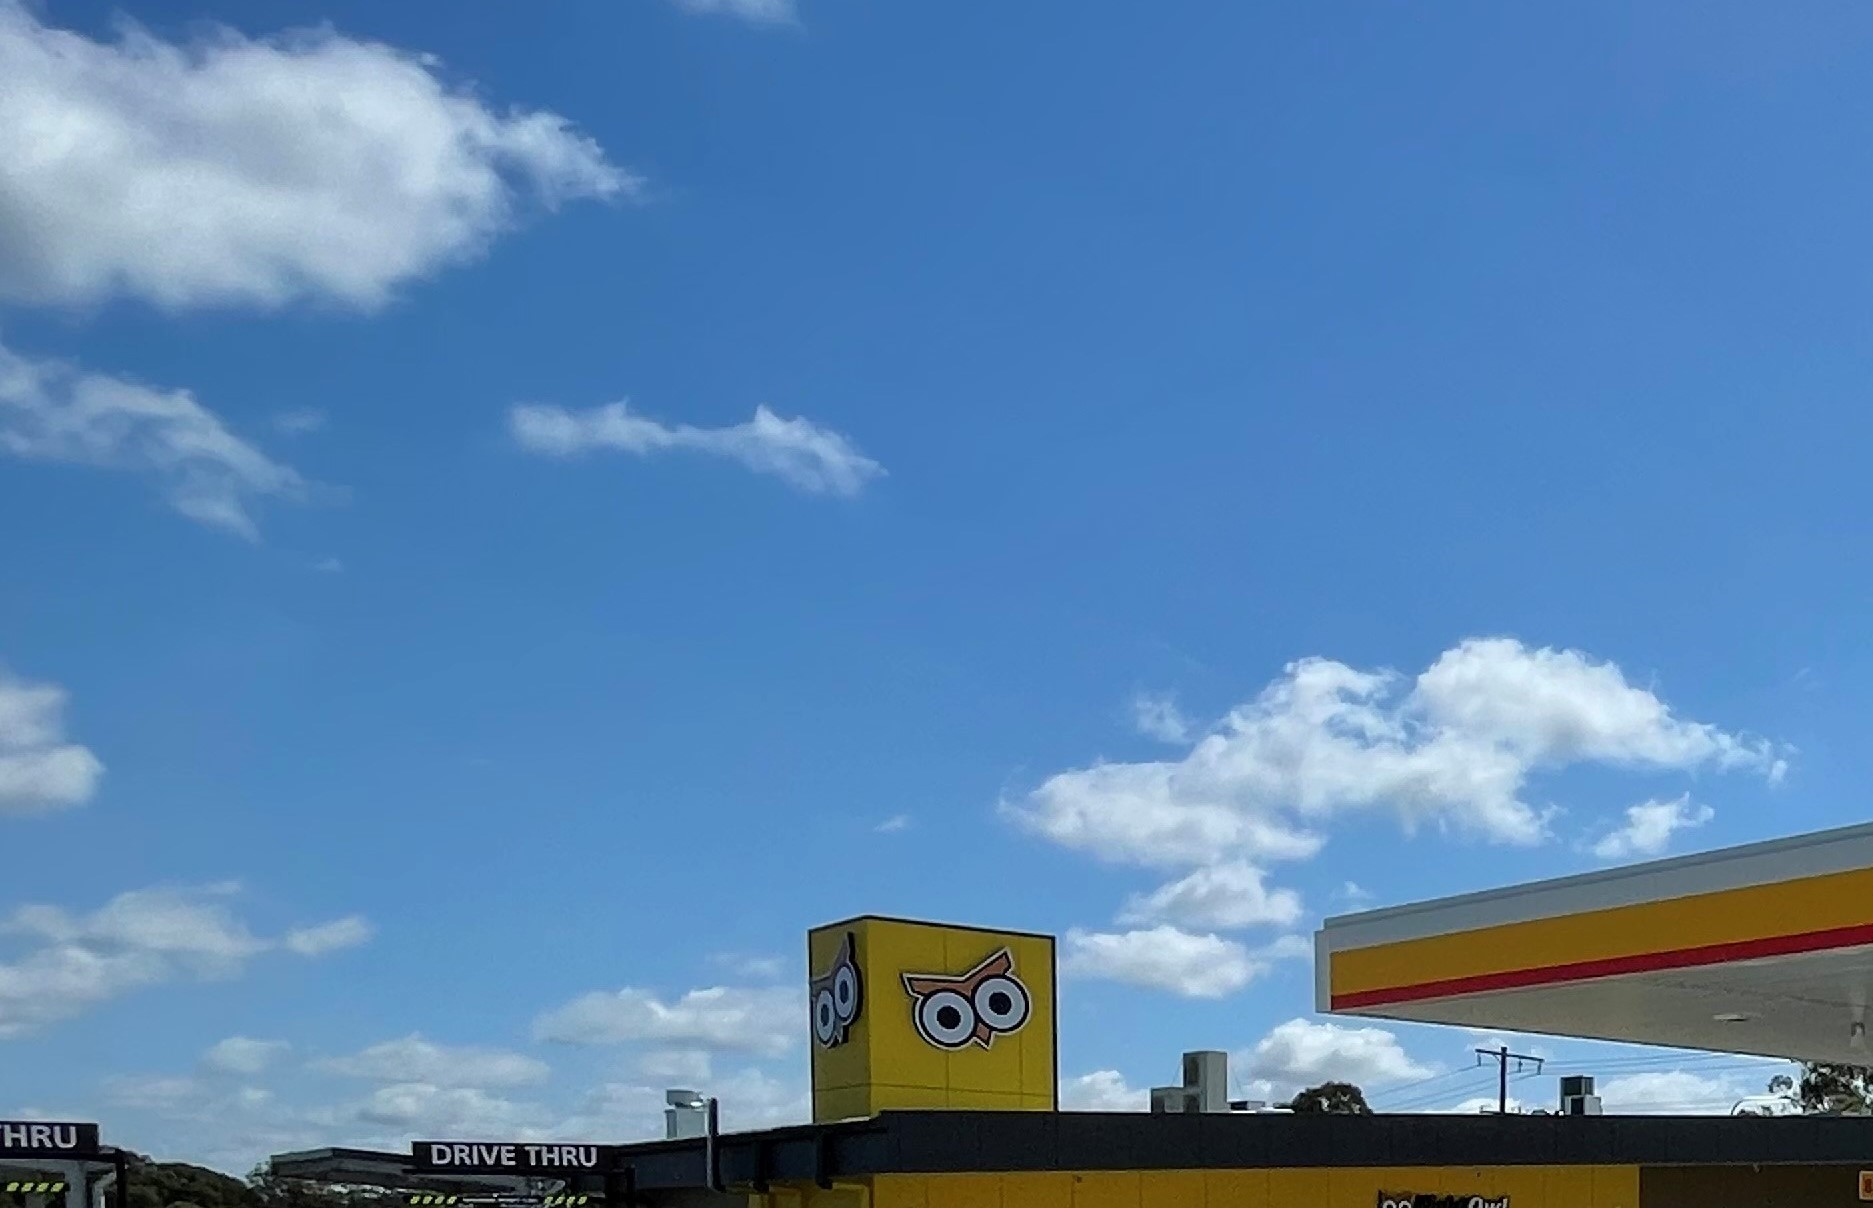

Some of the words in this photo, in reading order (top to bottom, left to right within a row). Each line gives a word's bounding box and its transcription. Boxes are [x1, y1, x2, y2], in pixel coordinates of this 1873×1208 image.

[0, 1124, 77, 1148] HRU
[430, 1144, 516, 1166] DRIVE
[524, 1146, 598, 1167] THRU
